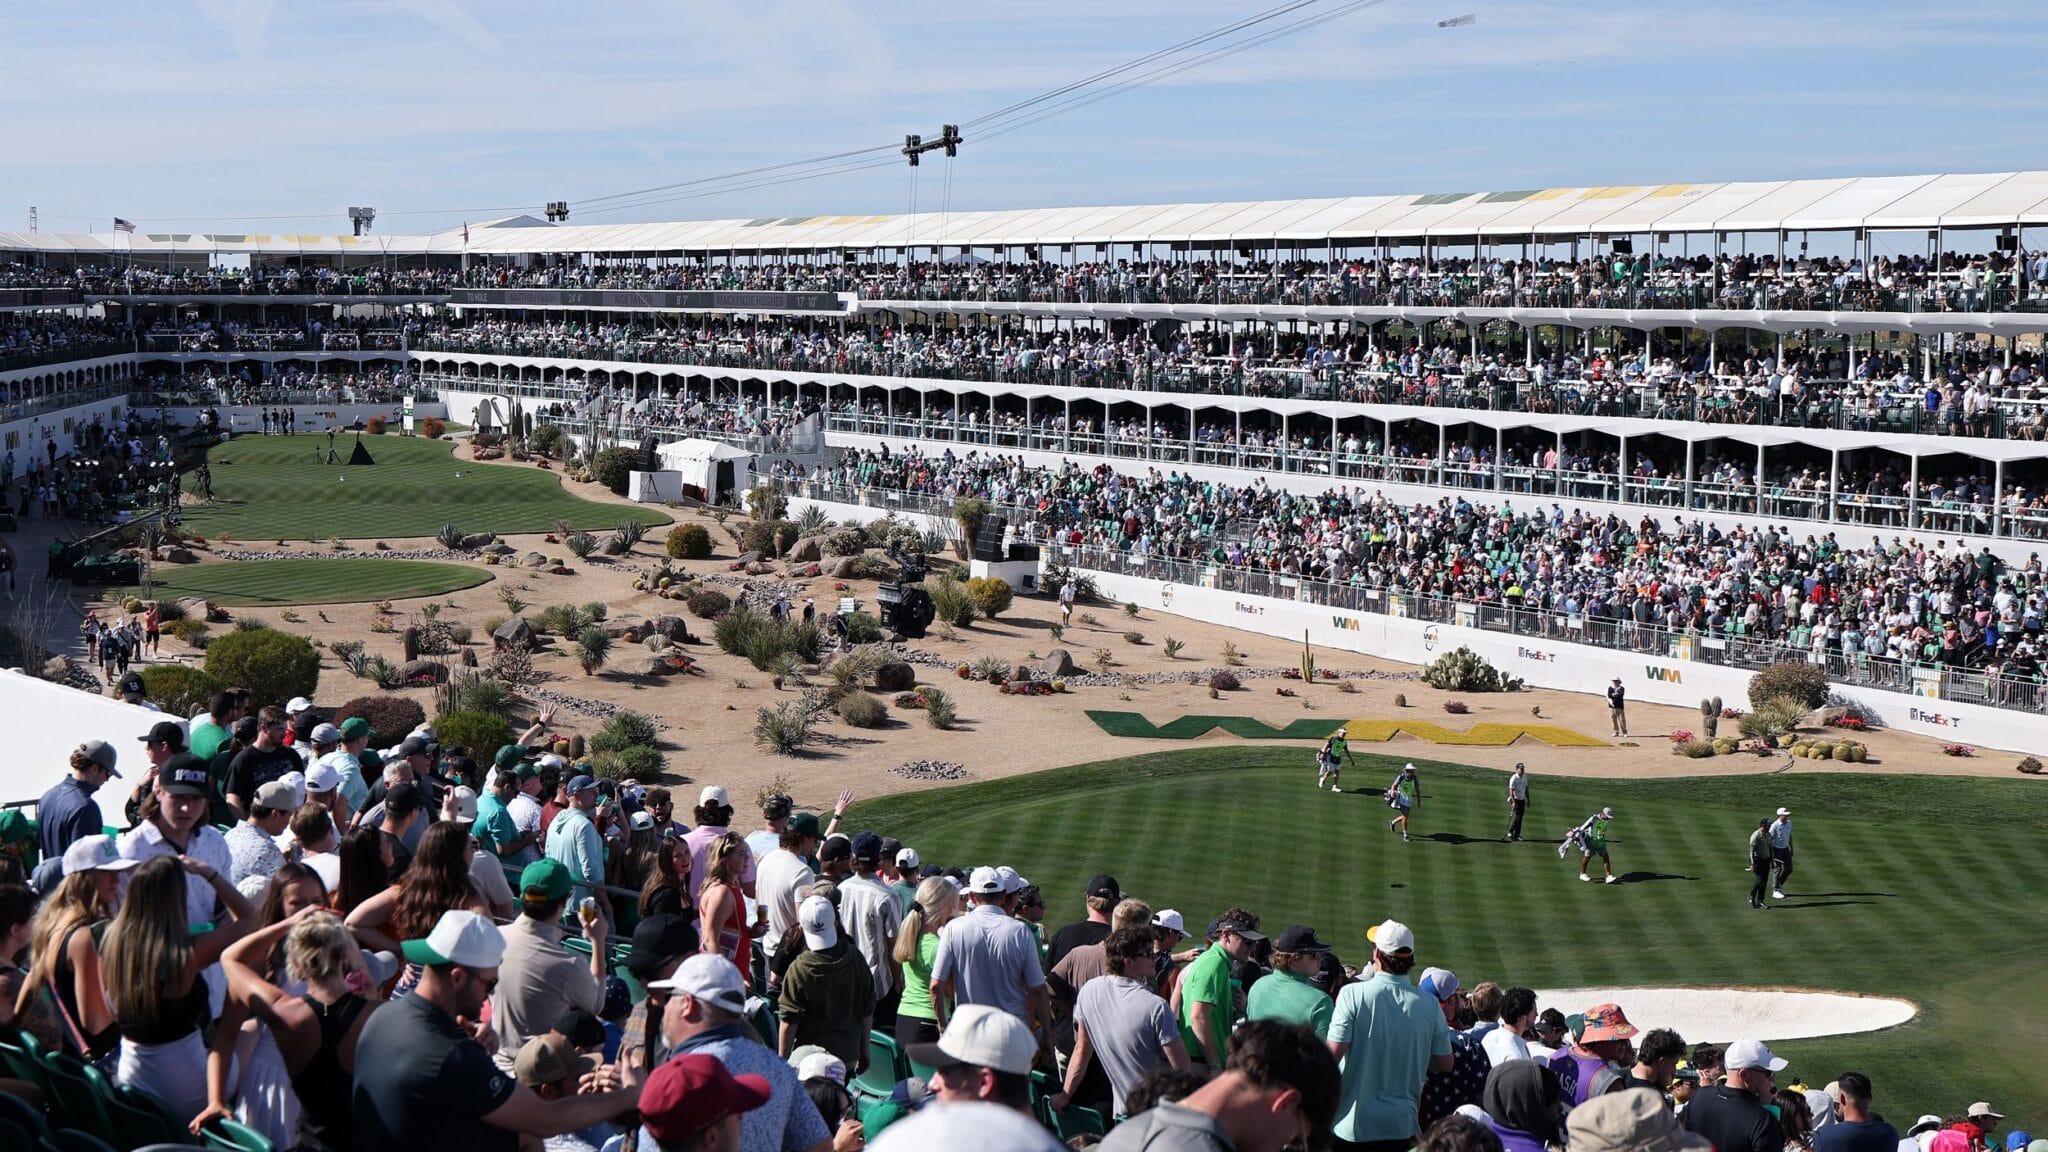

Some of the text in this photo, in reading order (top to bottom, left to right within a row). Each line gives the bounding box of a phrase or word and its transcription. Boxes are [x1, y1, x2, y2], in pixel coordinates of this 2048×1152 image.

[467, 293, 488, 302] TO HOLE
[614, 294, 628, 305] NICK
[717, 295, 784, 307] MACKENZIE HUGHES
[5, 430, 21, 451] WM
[1240, 603, 1258, 614] FedEx
[1332, 615, 1360, 631] WM
[1525, 648, 1548, 661] FedEx
[1645, 665, 1682, 684] WM
[1919, 710, 1949, 726] FedEx
[1555, 1071, 1578, 1097] ASH
